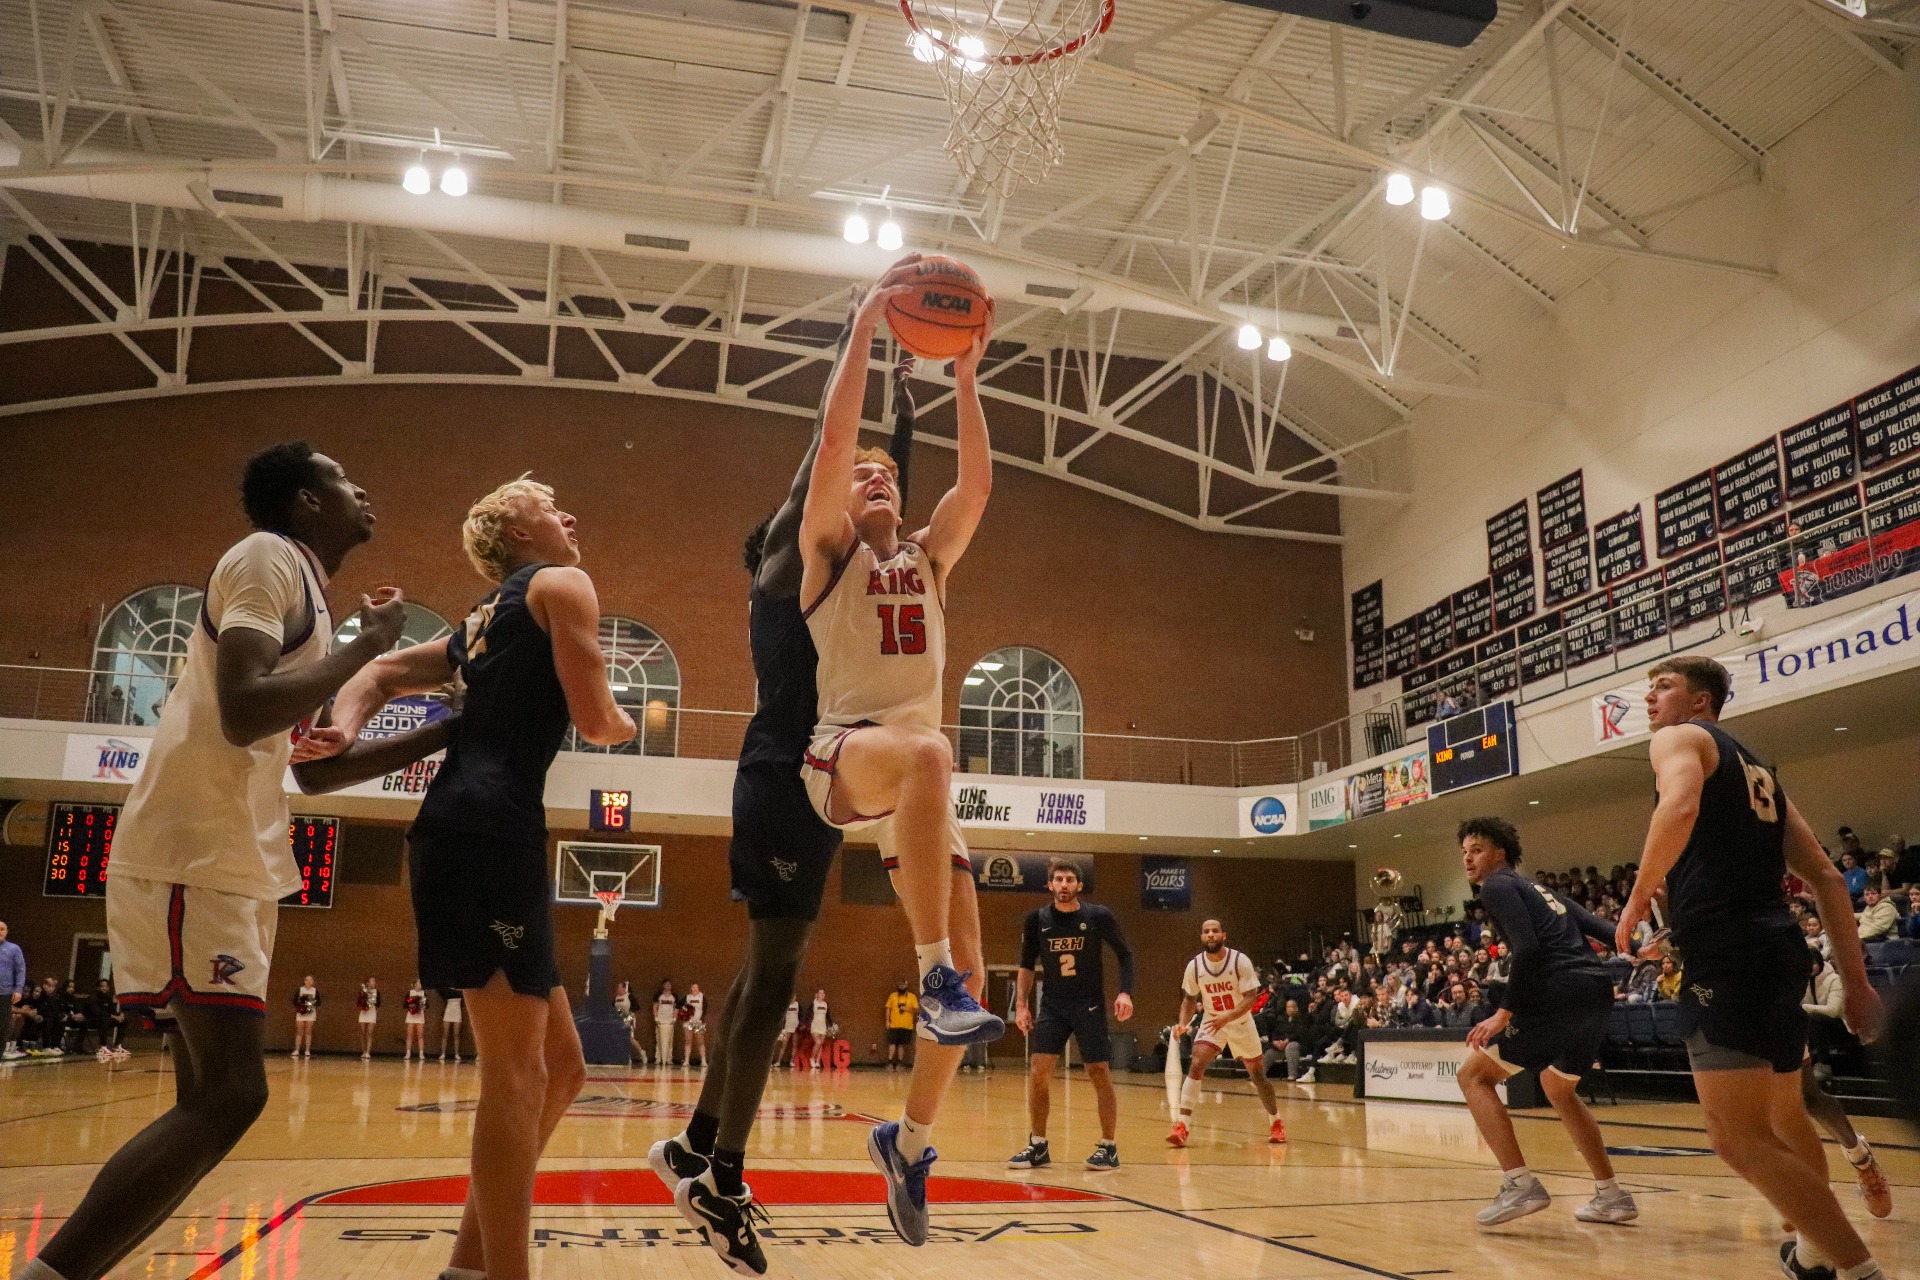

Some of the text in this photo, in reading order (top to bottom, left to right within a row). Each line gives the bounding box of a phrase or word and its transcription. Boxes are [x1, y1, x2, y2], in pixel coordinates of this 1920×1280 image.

[921, 291, 972, 316] NCAA
[1784, 410, 1850, 446] CONFERENCE CAROLINAS
[1866, 430, 1882, 447] MEN'S
[1889, 431, 1919, 456] 2019
[1791, 443, 1850, 478] MEN'S VOLLEYBALL
[1813, 465, 1840, 487] 2018
[1866, 473, 1903, 498] CONFERENCE
[1743, 498, 1767, 518] 2018
[1870, 512, 1891, 529] MEN'S
[1553, 523, 1571, 538] 2021
[1677, 531, 1696, 546] 2017
[1551, 548, 1581, 566] CHAMPIONS
[866, 567, 926, 596] KING
[1562, 583, 1577, 596] 2013
[877, 604, 927, 655] 15
[1528, 622, 1547, 637] NWCA
[1633, 625, 1649, 639] 2013
[1583, 645, 1598, 657] 2013
[1745, 604, 1920, 684] Tornad
[381, 704, 427, 714] PIONS
[367, 716, 426, 731] BODY
[98, 750, 139, 768] KING
[1435, 748, 1453, 764] KING
[404, 760, 442, 776] NOR
[382, 775, 430, 792] GREEN
[1366, 772, 1383, 786] Metz
[602, 792, 628, 806] 3:50
[959, 788, 988, 804] UNC
[1040, 792, 1085, 809] YOUNG
[1311, 787, 1335, 809] HMG
[67, 813, 114, 827] 3 0 2
[604, 806, 624, 827] 16
[956, 804, 1011, 822] MBROKE
[1037, 808, 1087, 825] HARRIS
[1254, 813, 1285, 826] NCAA
[60, 828, 72, 837] 11
[104, 829, 113, 840] 0
[307, 825, 315, 837] 0
[327, 826, 335, 838] 3
[58, 841, 70, 852] 15
[104, 843, 111, 854] 3
[325, 840, 333, 851] 2
[52, 854, 109, 868] 20 0 2
[324, 853, 331, 865] 5
[51, 868, 107, 882] 30 0 0
[303, 865, 331, 878] 0 10
[77, 883, 85, 893] 9
[302, 879, 330, 892] 0 2
[301, 893, 309, 905] 5
[1048, 936, 1085, 952] E&H
[1060, 953, 1077, 977] 2
[1204, 981, 1234, 994] KING
[1401, 1061, 1433, 1071] COURTYARD
